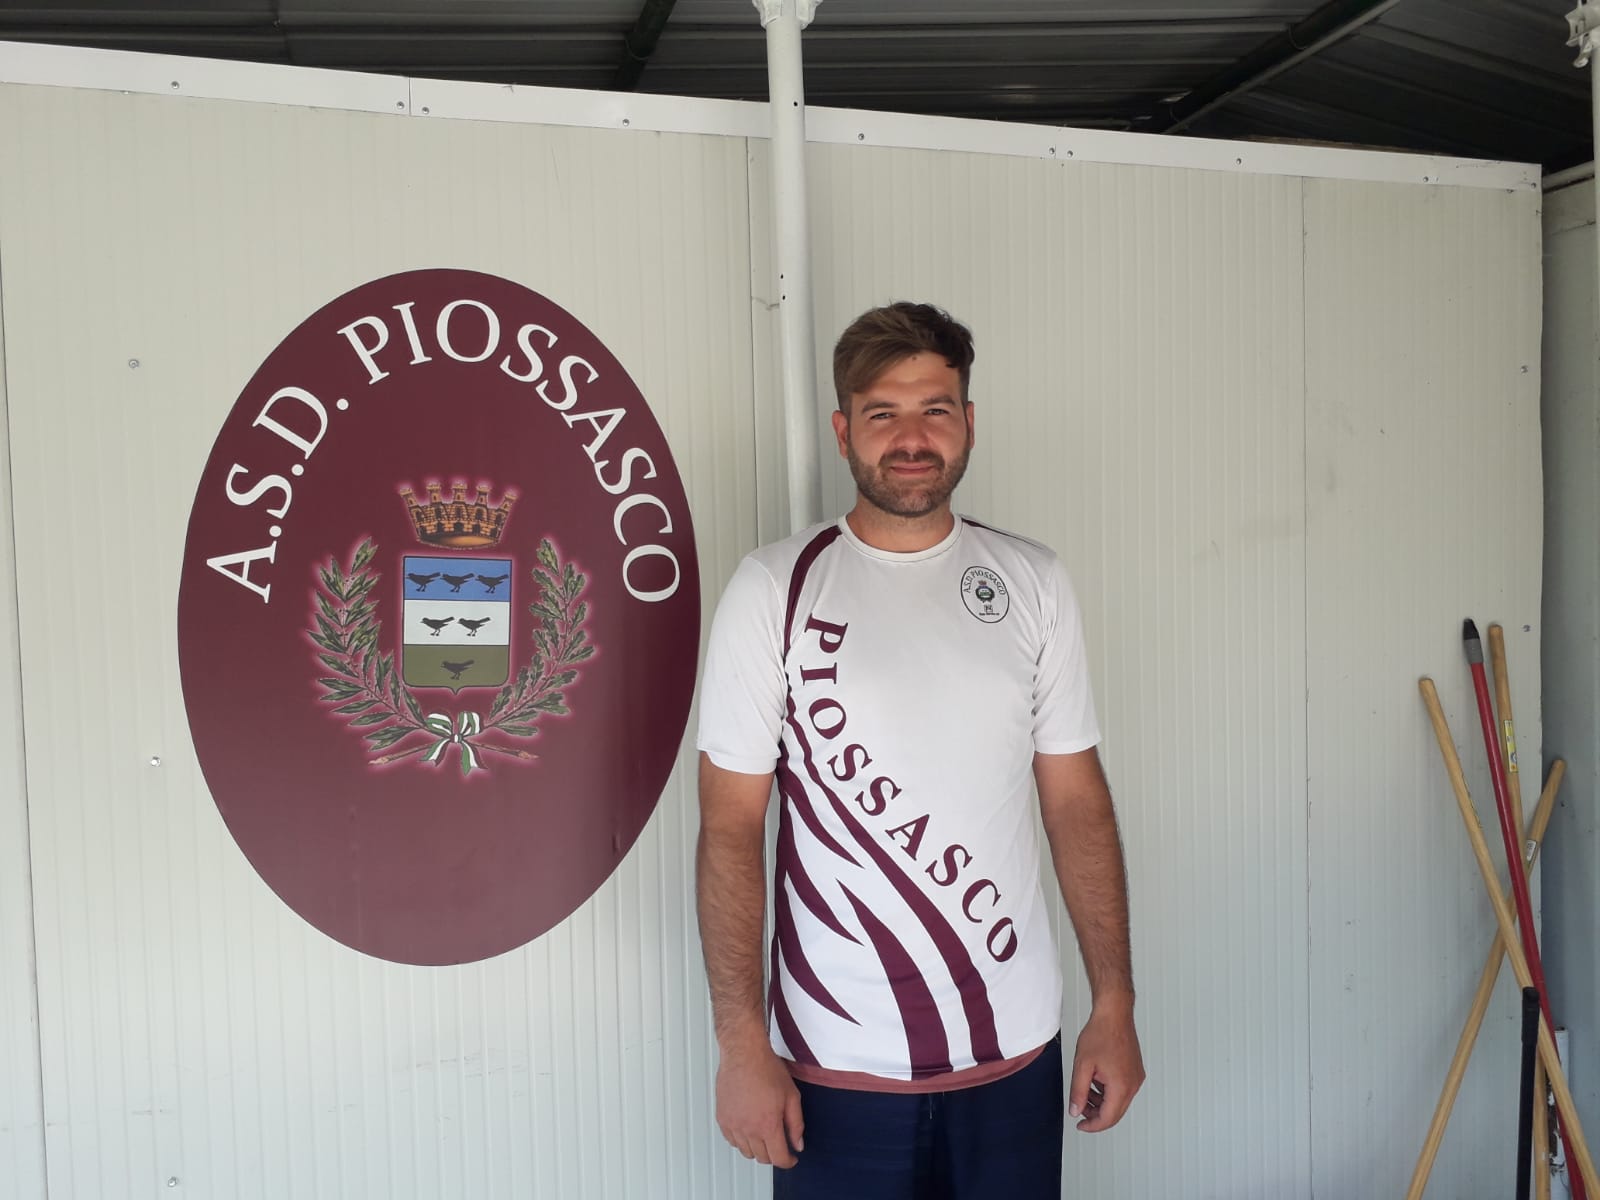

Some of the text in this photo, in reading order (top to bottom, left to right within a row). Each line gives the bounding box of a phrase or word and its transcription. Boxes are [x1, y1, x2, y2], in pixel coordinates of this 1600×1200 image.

[206, 299, 681, 604] A.S.D. PIOSSASCO
[971, 569, 1007, 595] PIOSSASCO
[799, 613, 1018, 963] PIOSSASCO
